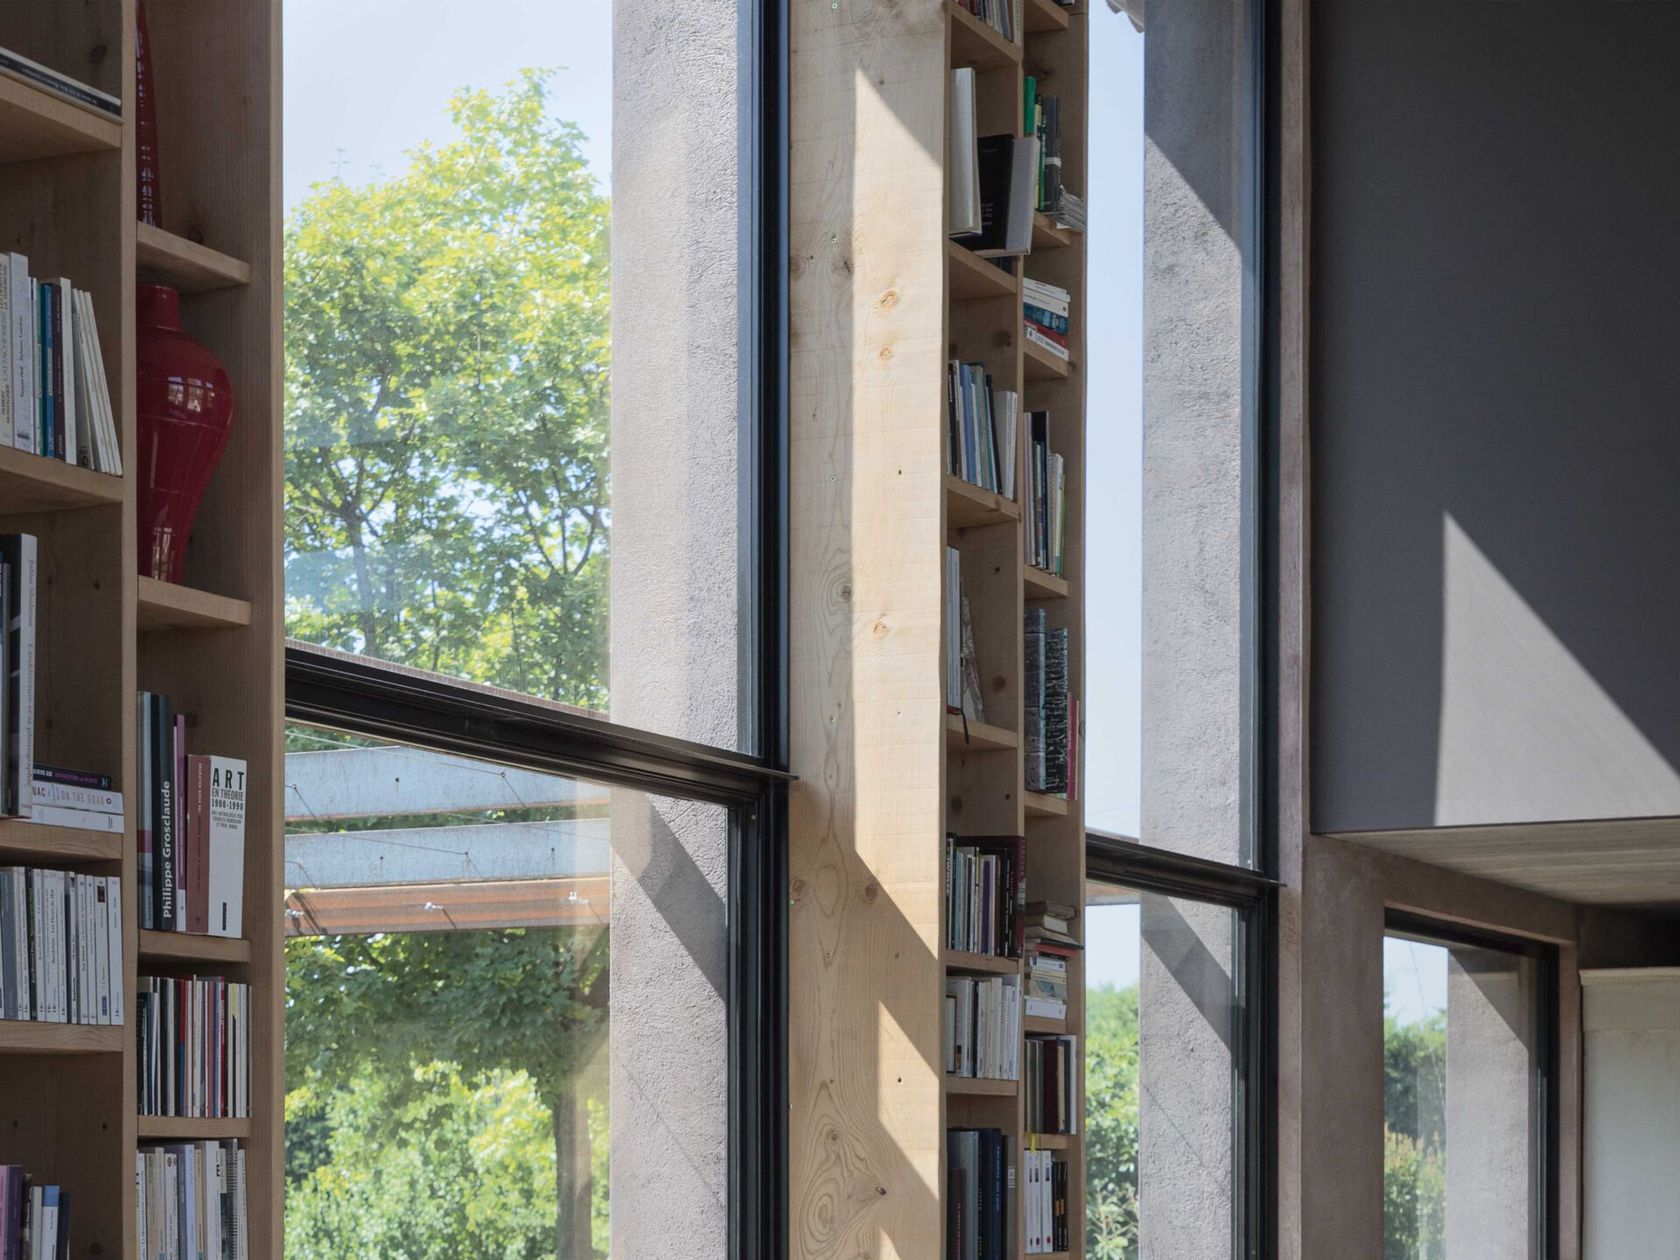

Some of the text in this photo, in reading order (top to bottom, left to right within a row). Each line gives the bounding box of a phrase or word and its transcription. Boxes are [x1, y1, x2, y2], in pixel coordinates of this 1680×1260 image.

[212, 768, 245, 790] ART
[72, 791, 85, 804] THE
[87, 793, 105, 806] ROAD
[211, 788, 220, 798] EN
[211, 799, 244, 811] 1900-1990
[161, 780, 173, 919] Philippe Grosclaude
